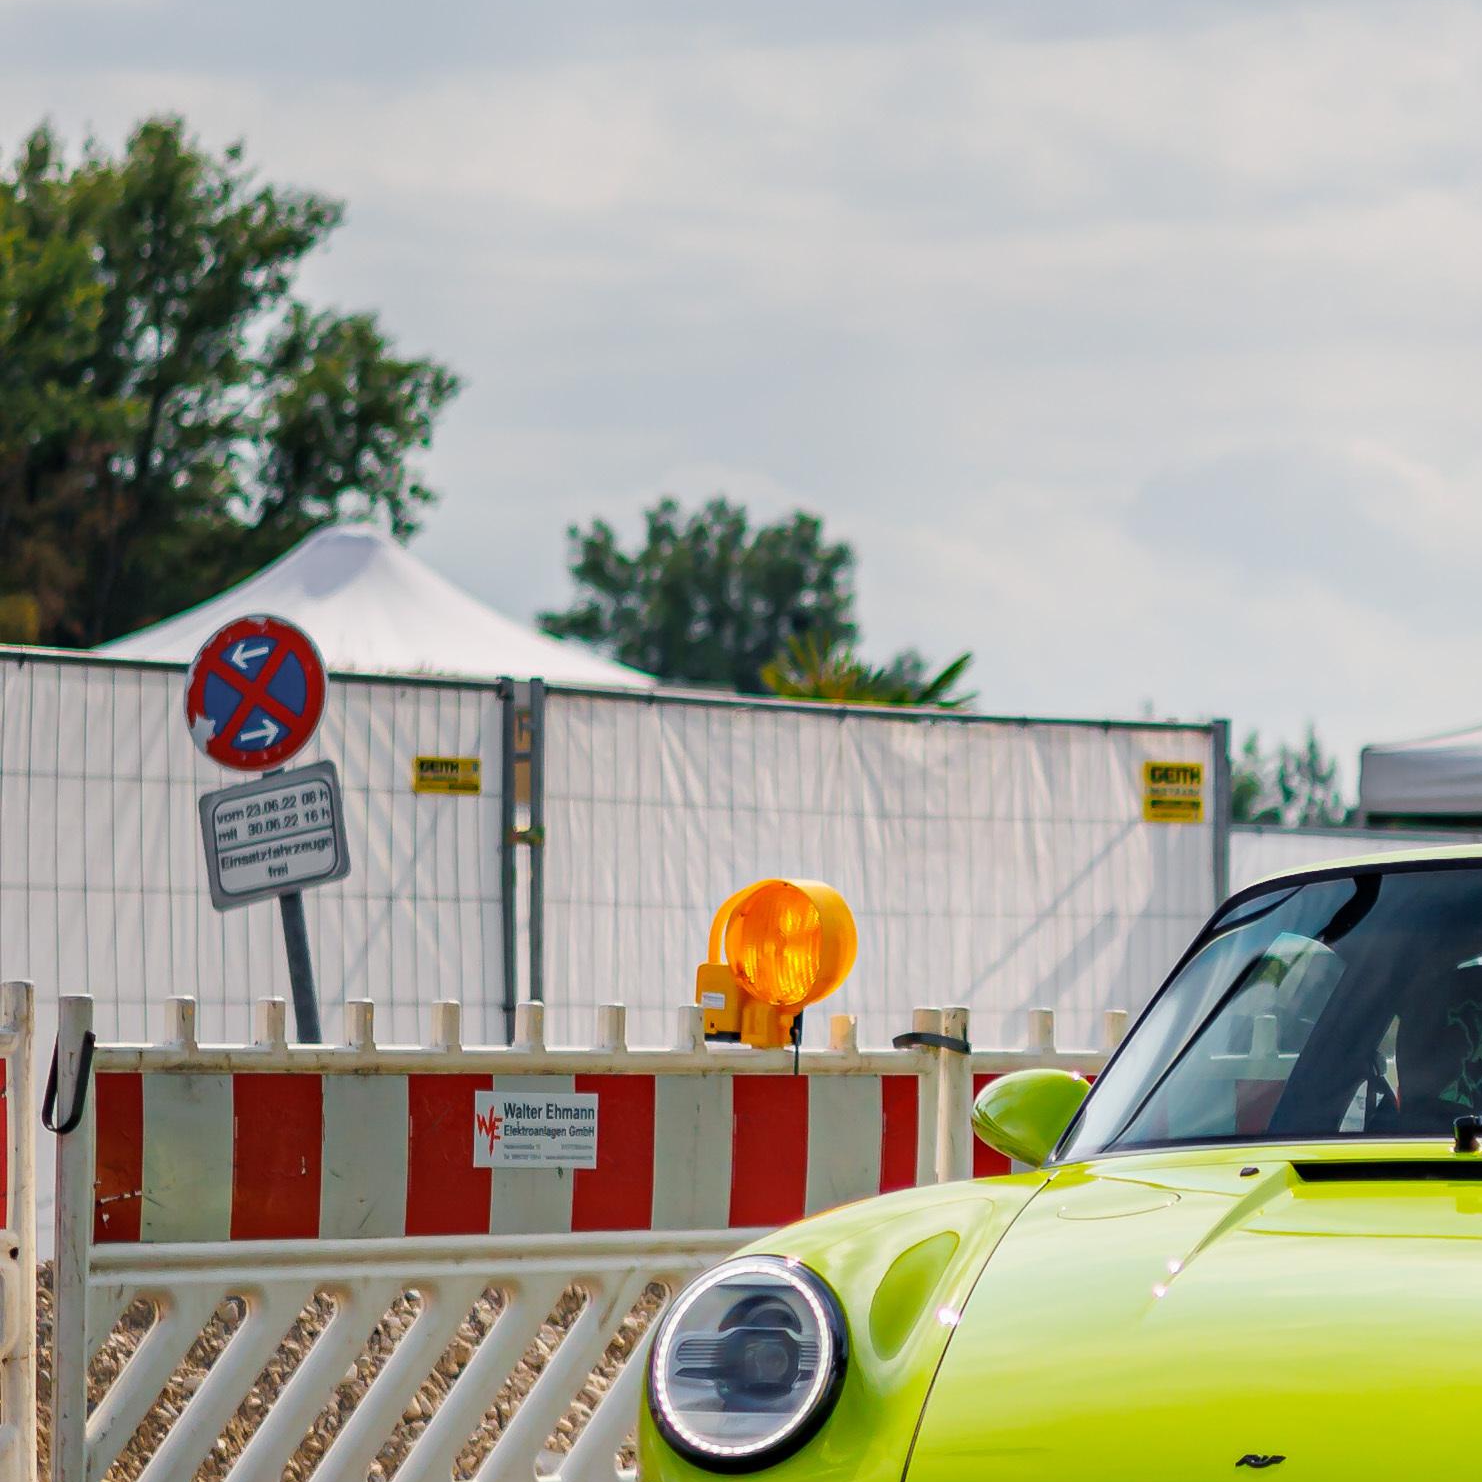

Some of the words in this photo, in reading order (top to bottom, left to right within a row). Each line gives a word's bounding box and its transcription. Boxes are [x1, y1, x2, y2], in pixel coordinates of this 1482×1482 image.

[216, 808, 244, 825] vom
[503, 1102, 543, 1120] Walter
[546, 1103, 595, 1120] Ehmann
[503, 1124, 567, 1139] Elektroanlagen
[569, 1125, 595, 1137] GmbH
